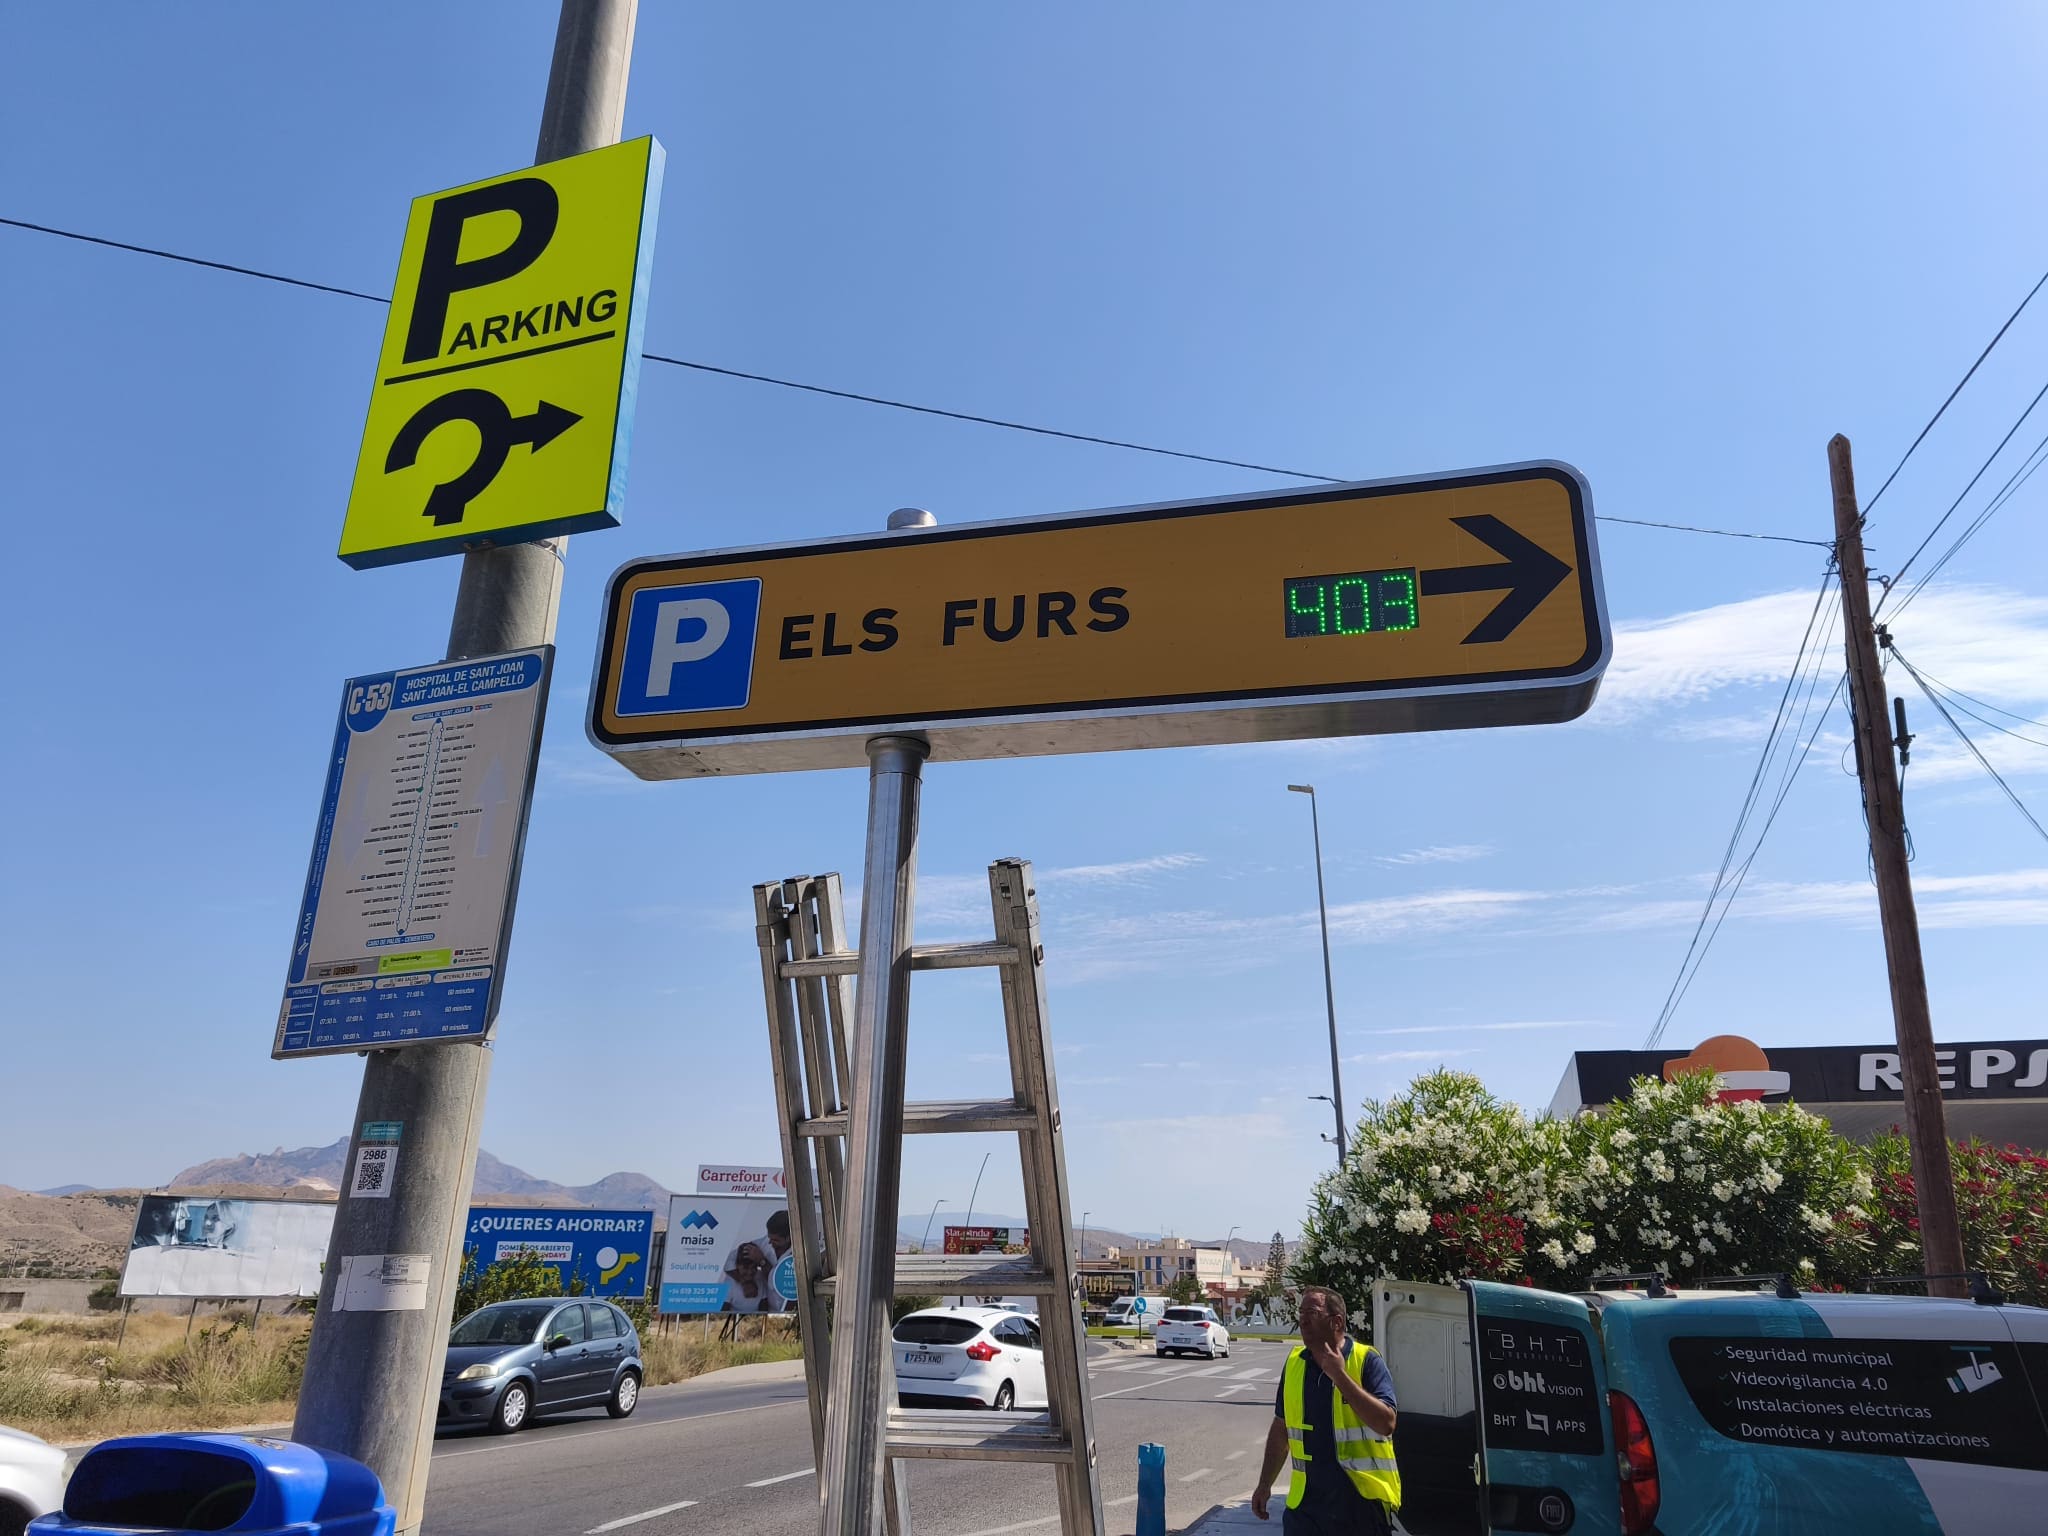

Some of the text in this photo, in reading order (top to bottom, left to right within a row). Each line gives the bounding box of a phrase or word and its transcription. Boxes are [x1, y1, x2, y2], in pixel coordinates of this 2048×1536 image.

[402, 177, 617, 364] PARKING
[1290, 575, 1416, 635] 403
[779, 587, 1130, 660] ELS FURS
[645, 597, 731, 698] P
[407, 660, 524, 690] HOSPITAL DE SANT JOAN
[401, 674, 525, 704] SANT JOAN-EL CAMPELLO
[302, 912, 312, 935] TAM
[363, 1150, 388, 1160] 2988
[701, 1168, 768, 1182] Carrefour
[731, 1183, 766, 1193] market
[470, 1216, 645, 1233] ¿QUIERES AHORRAR?
[541, 1244, 571, 1252] ABIERTO
[681, 1234, 714, 1245] maisa
[1725, 1346, 1893, 1368] Seguridad municipal
[1508, 1370, 1546, 1394] bht
[1730, 1370, 1888, 1391] Videovigilancia 4.0
[1736, 1397, 1932, 1420] Instalaciones eléctricas
[1493, 1413, 1586, 1433] BHT APPS
[1741, 1422, 1990, 1449] Domótica y automatizaciones
